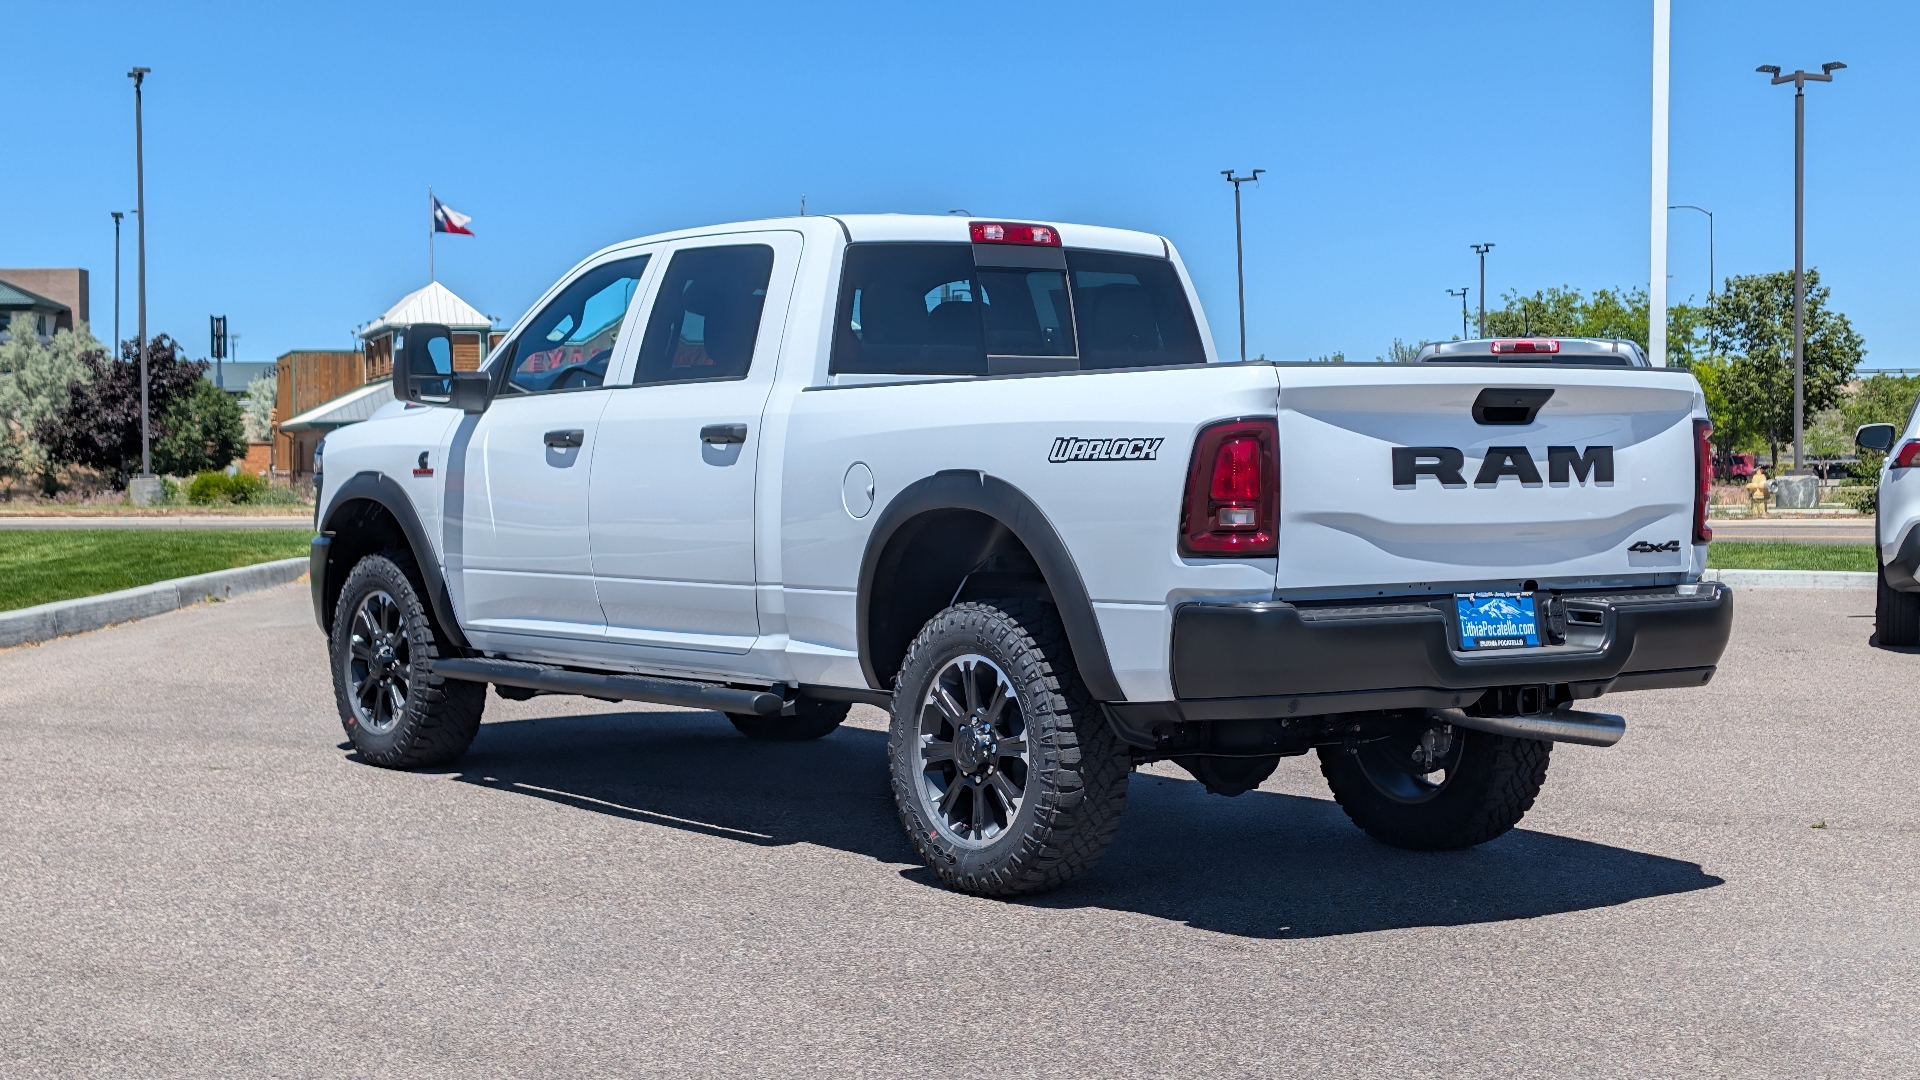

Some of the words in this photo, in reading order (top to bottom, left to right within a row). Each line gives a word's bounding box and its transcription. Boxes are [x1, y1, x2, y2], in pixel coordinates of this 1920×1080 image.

[517, 348, 606, 373] EXA
[1048, 437, 1165, 463] WARLOCK
[1392, 446, 1614, 486] RAM
[1627, 540, 1681, 553] 4x4
[1461, 620, 1536, 637] LithiaPocatello.com
[976, 633, 1038, 782] WRANGLER
[896, 717, 957, 867] GOODYEAR
